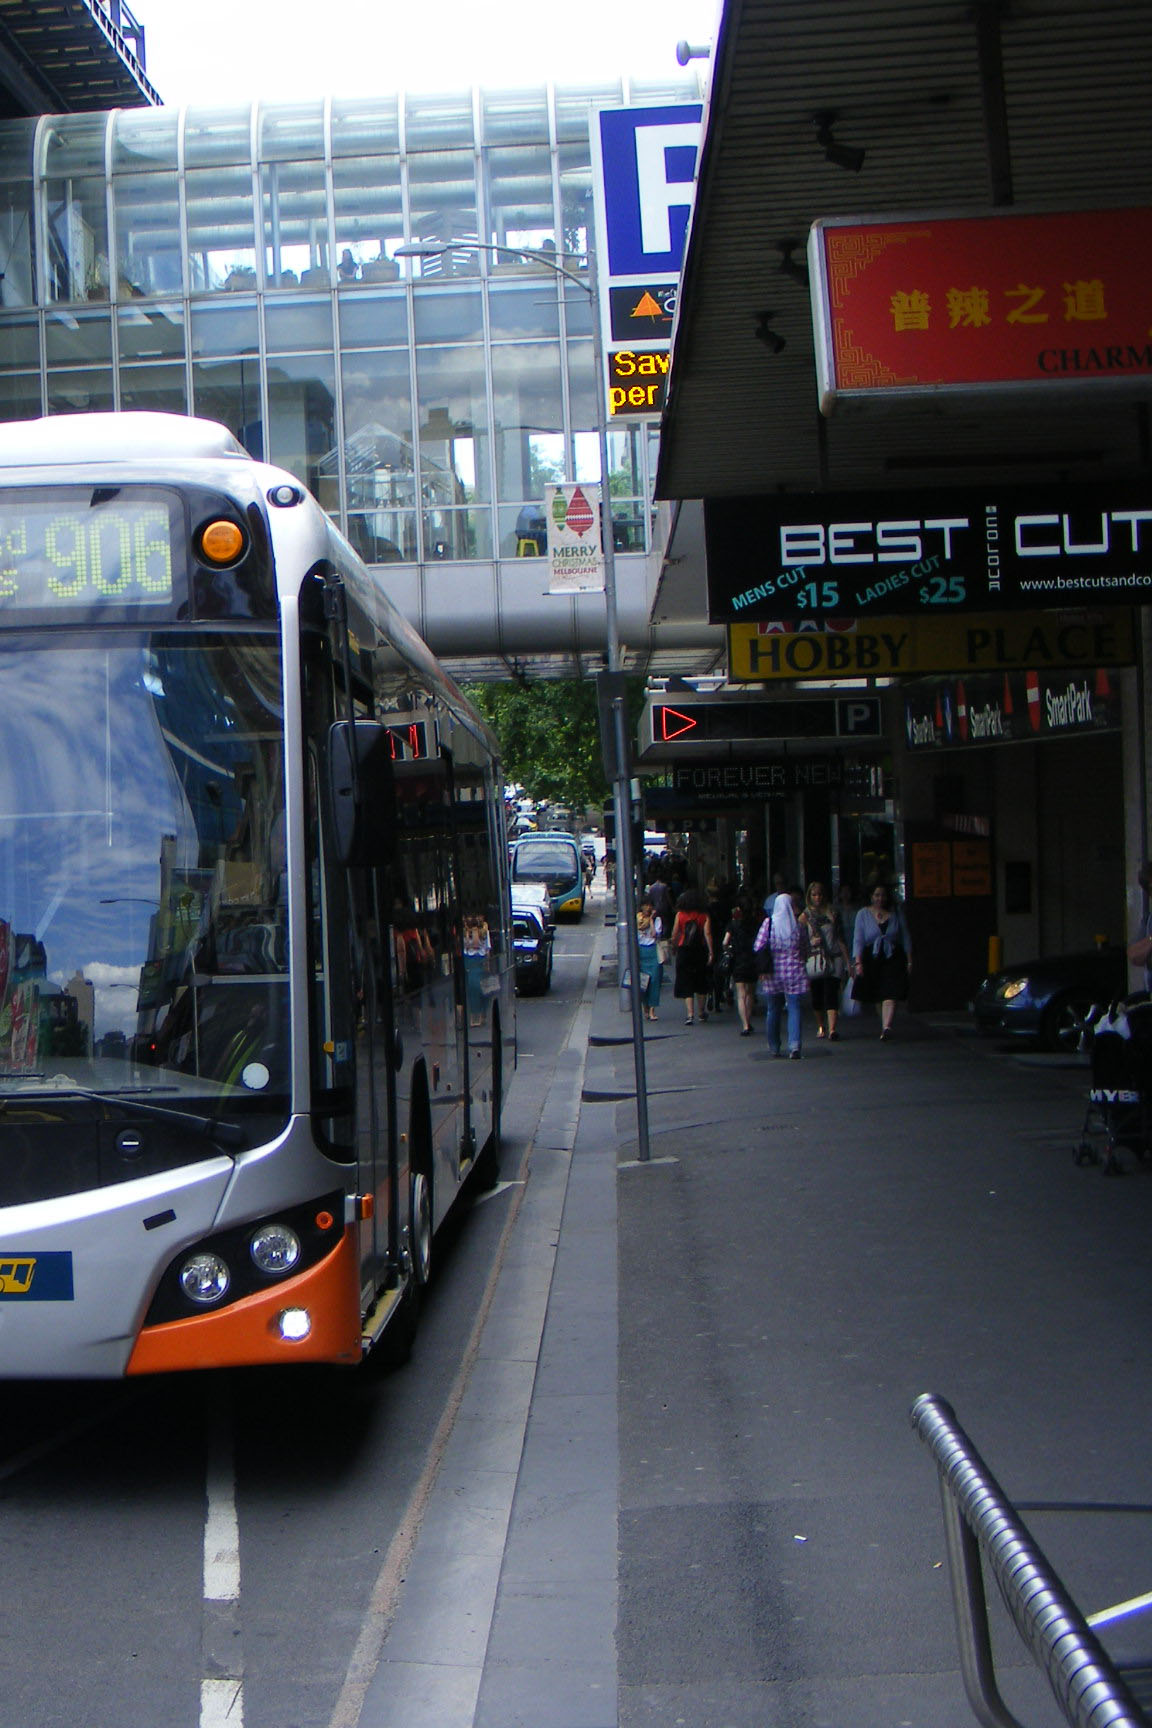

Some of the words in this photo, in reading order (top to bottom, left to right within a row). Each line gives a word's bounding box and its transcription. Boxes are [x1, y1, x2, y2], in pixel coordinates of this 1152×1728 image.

[889, 279, 1109, 332] 普辣之道
[609, 385, 659, 415] per
[46, 512, 173, 598] 906
[553, 545, 597, 558] MERRY
[780, 518, 969, 567] BEST
[552, 558, 597, 568] CHRISTMAS
[554, 566, 598, 576] MELBOURNE
[731, 579, 776, 611] MENS
[776, 565, 809, 589] CUT
[796, 580, 840, 609] $15
[855, 569, 910, 607] LADIES
[910, 554, 942, 579] CUT
[919, 575, 967, 605] $25
[749, 633, 908, 673] HOBBY
[967, 623, 1116, 664] PLACE
[847, 704, 871, 732] P
[1046, 680, 1093, 728] SmartPark
[677, 766, 786, 788] FOREVER
